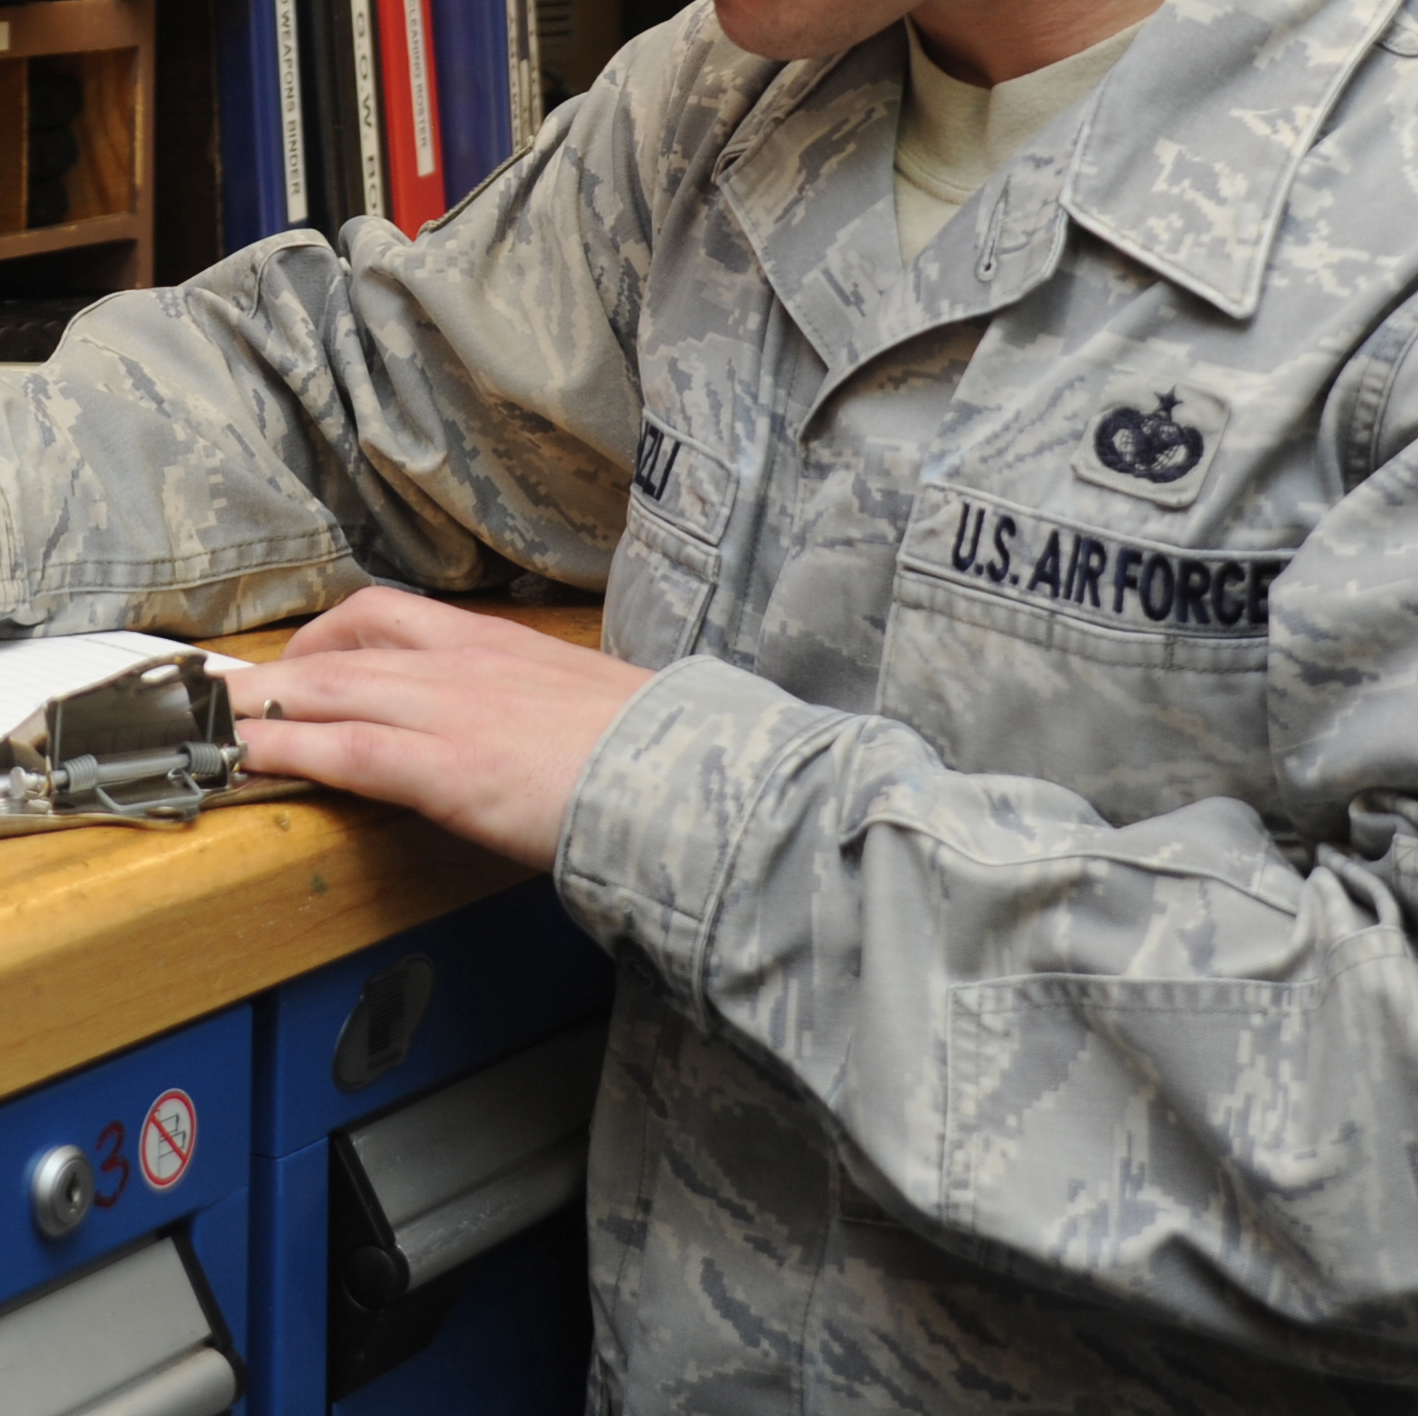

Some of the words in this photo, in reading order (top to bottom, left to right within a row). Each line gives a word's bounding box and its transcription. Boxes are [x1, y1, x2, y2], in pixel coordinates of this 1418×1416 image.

[280, 11, 295, 114] WEAPONS
[287, 120, 302, 196] BINDER
[952, 501, 1019, 584] U.S.
[1027, 529, 1107, 608] AIR
[1112, 549, 1288, 626] FORCE
[93, 1120, 130, 1210] 3
